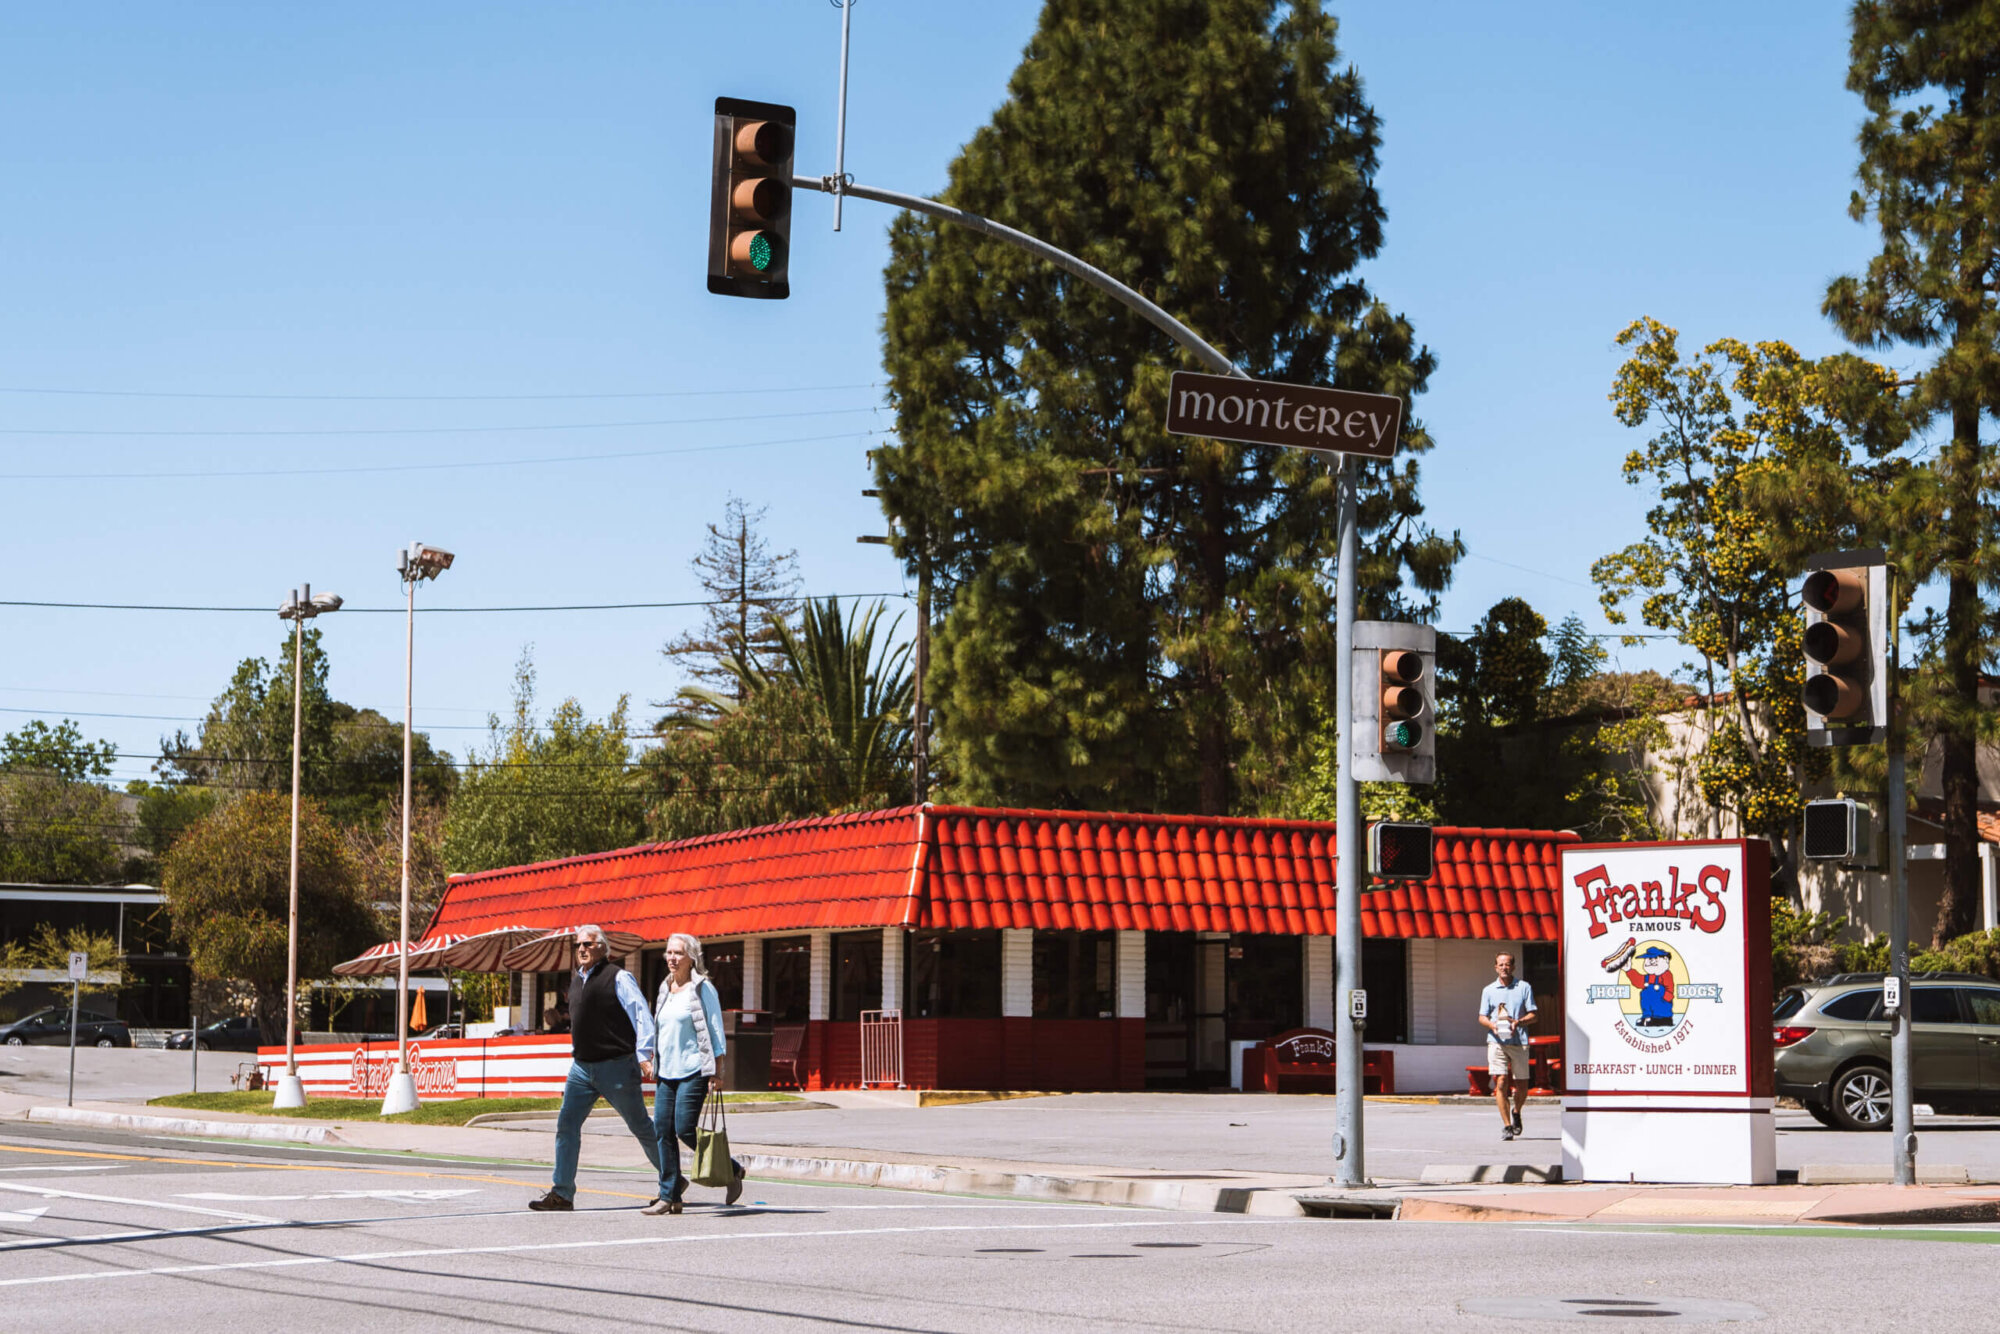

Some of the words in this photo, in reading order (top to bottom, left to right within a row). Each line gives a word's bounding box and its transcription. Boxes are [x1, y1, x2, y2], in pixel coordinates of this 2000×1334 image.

[1629, 921, 1682, 932] FAMOUS
[1595, 986, 1626, 998] HOT
[1678, 986, 1717, 998] DOGS
[1613, 1019, 1672, 1054] Established
[1673, 1019, 1695, 1046] 1977
[1573, 1063, 1637, 1076] BREAKFAST
[1646, 1064, 1683, 1076] LUNCH
[1693, 1064, 1738, 1076] DINNER
